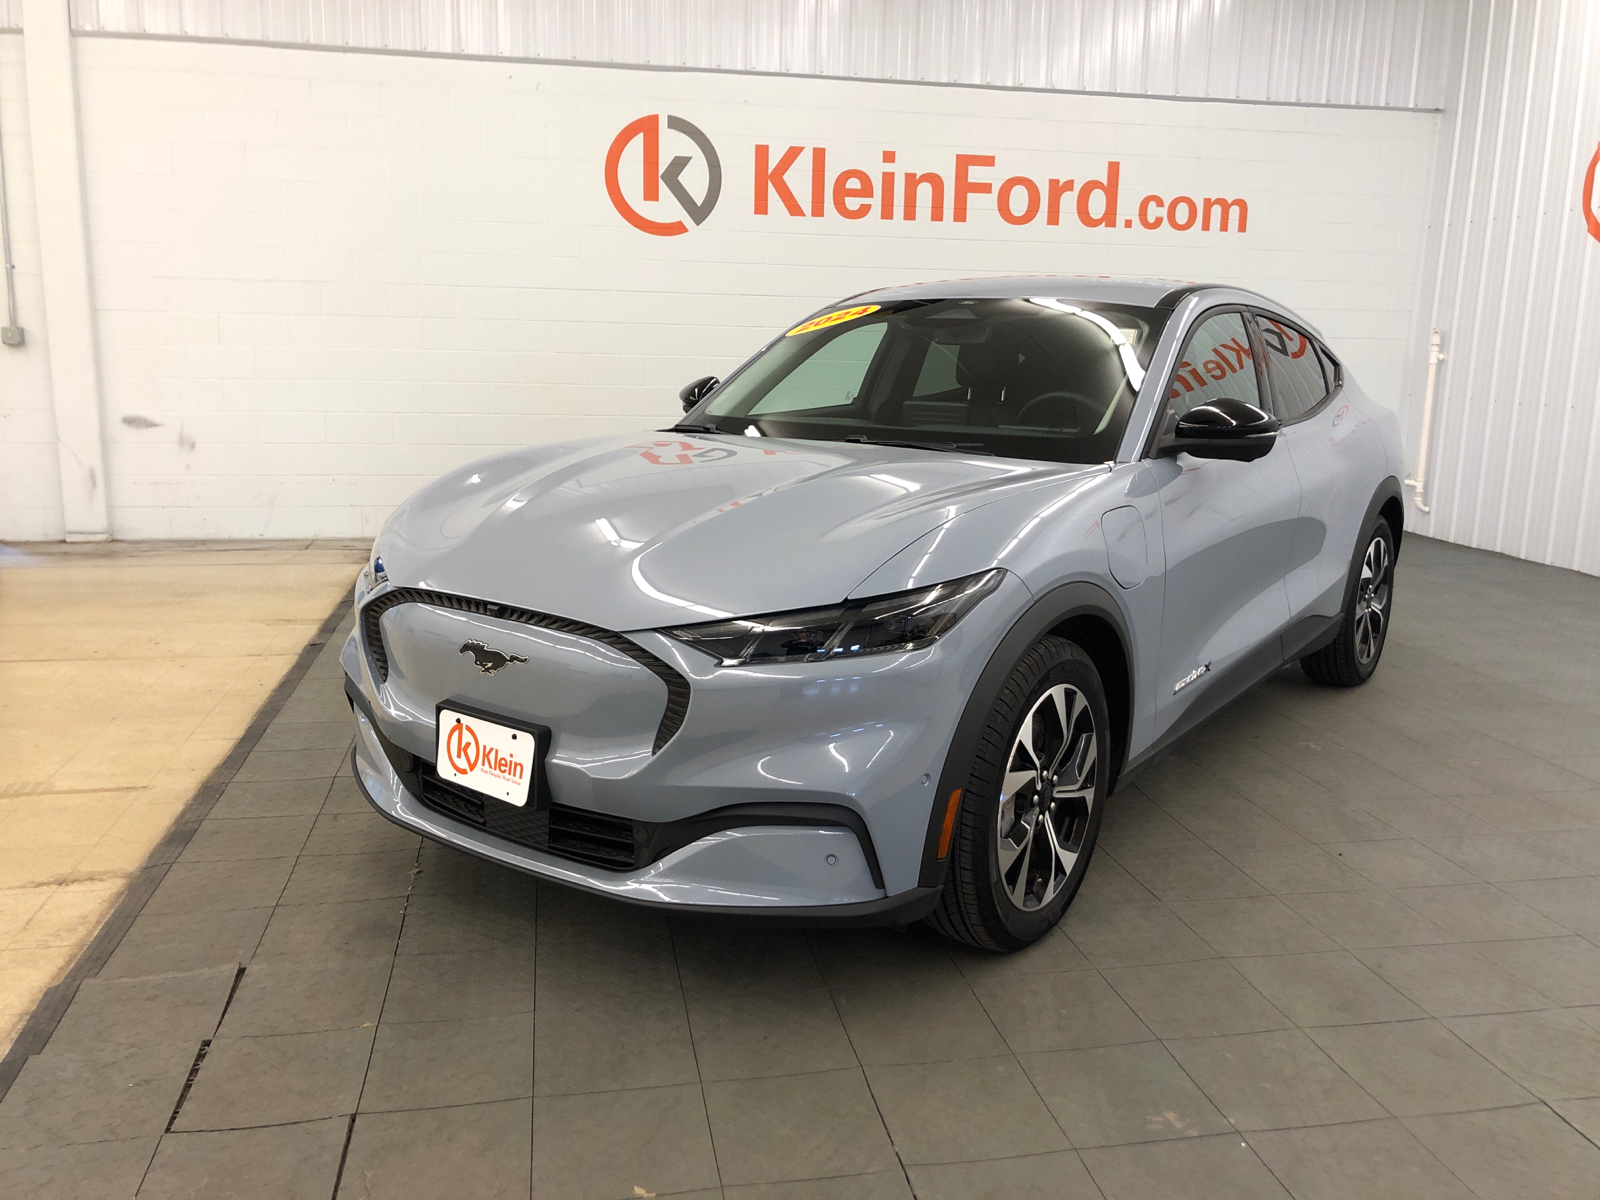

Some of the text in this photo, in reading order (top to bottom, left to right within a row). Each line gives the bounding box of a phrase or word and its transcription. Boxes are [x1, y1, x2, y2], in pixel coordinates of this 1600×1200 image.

[753, 144, 1248, 234] KleinFord.com
[795, 306, 872, 333] 2024
[481, 744, 524, 780] Klein
